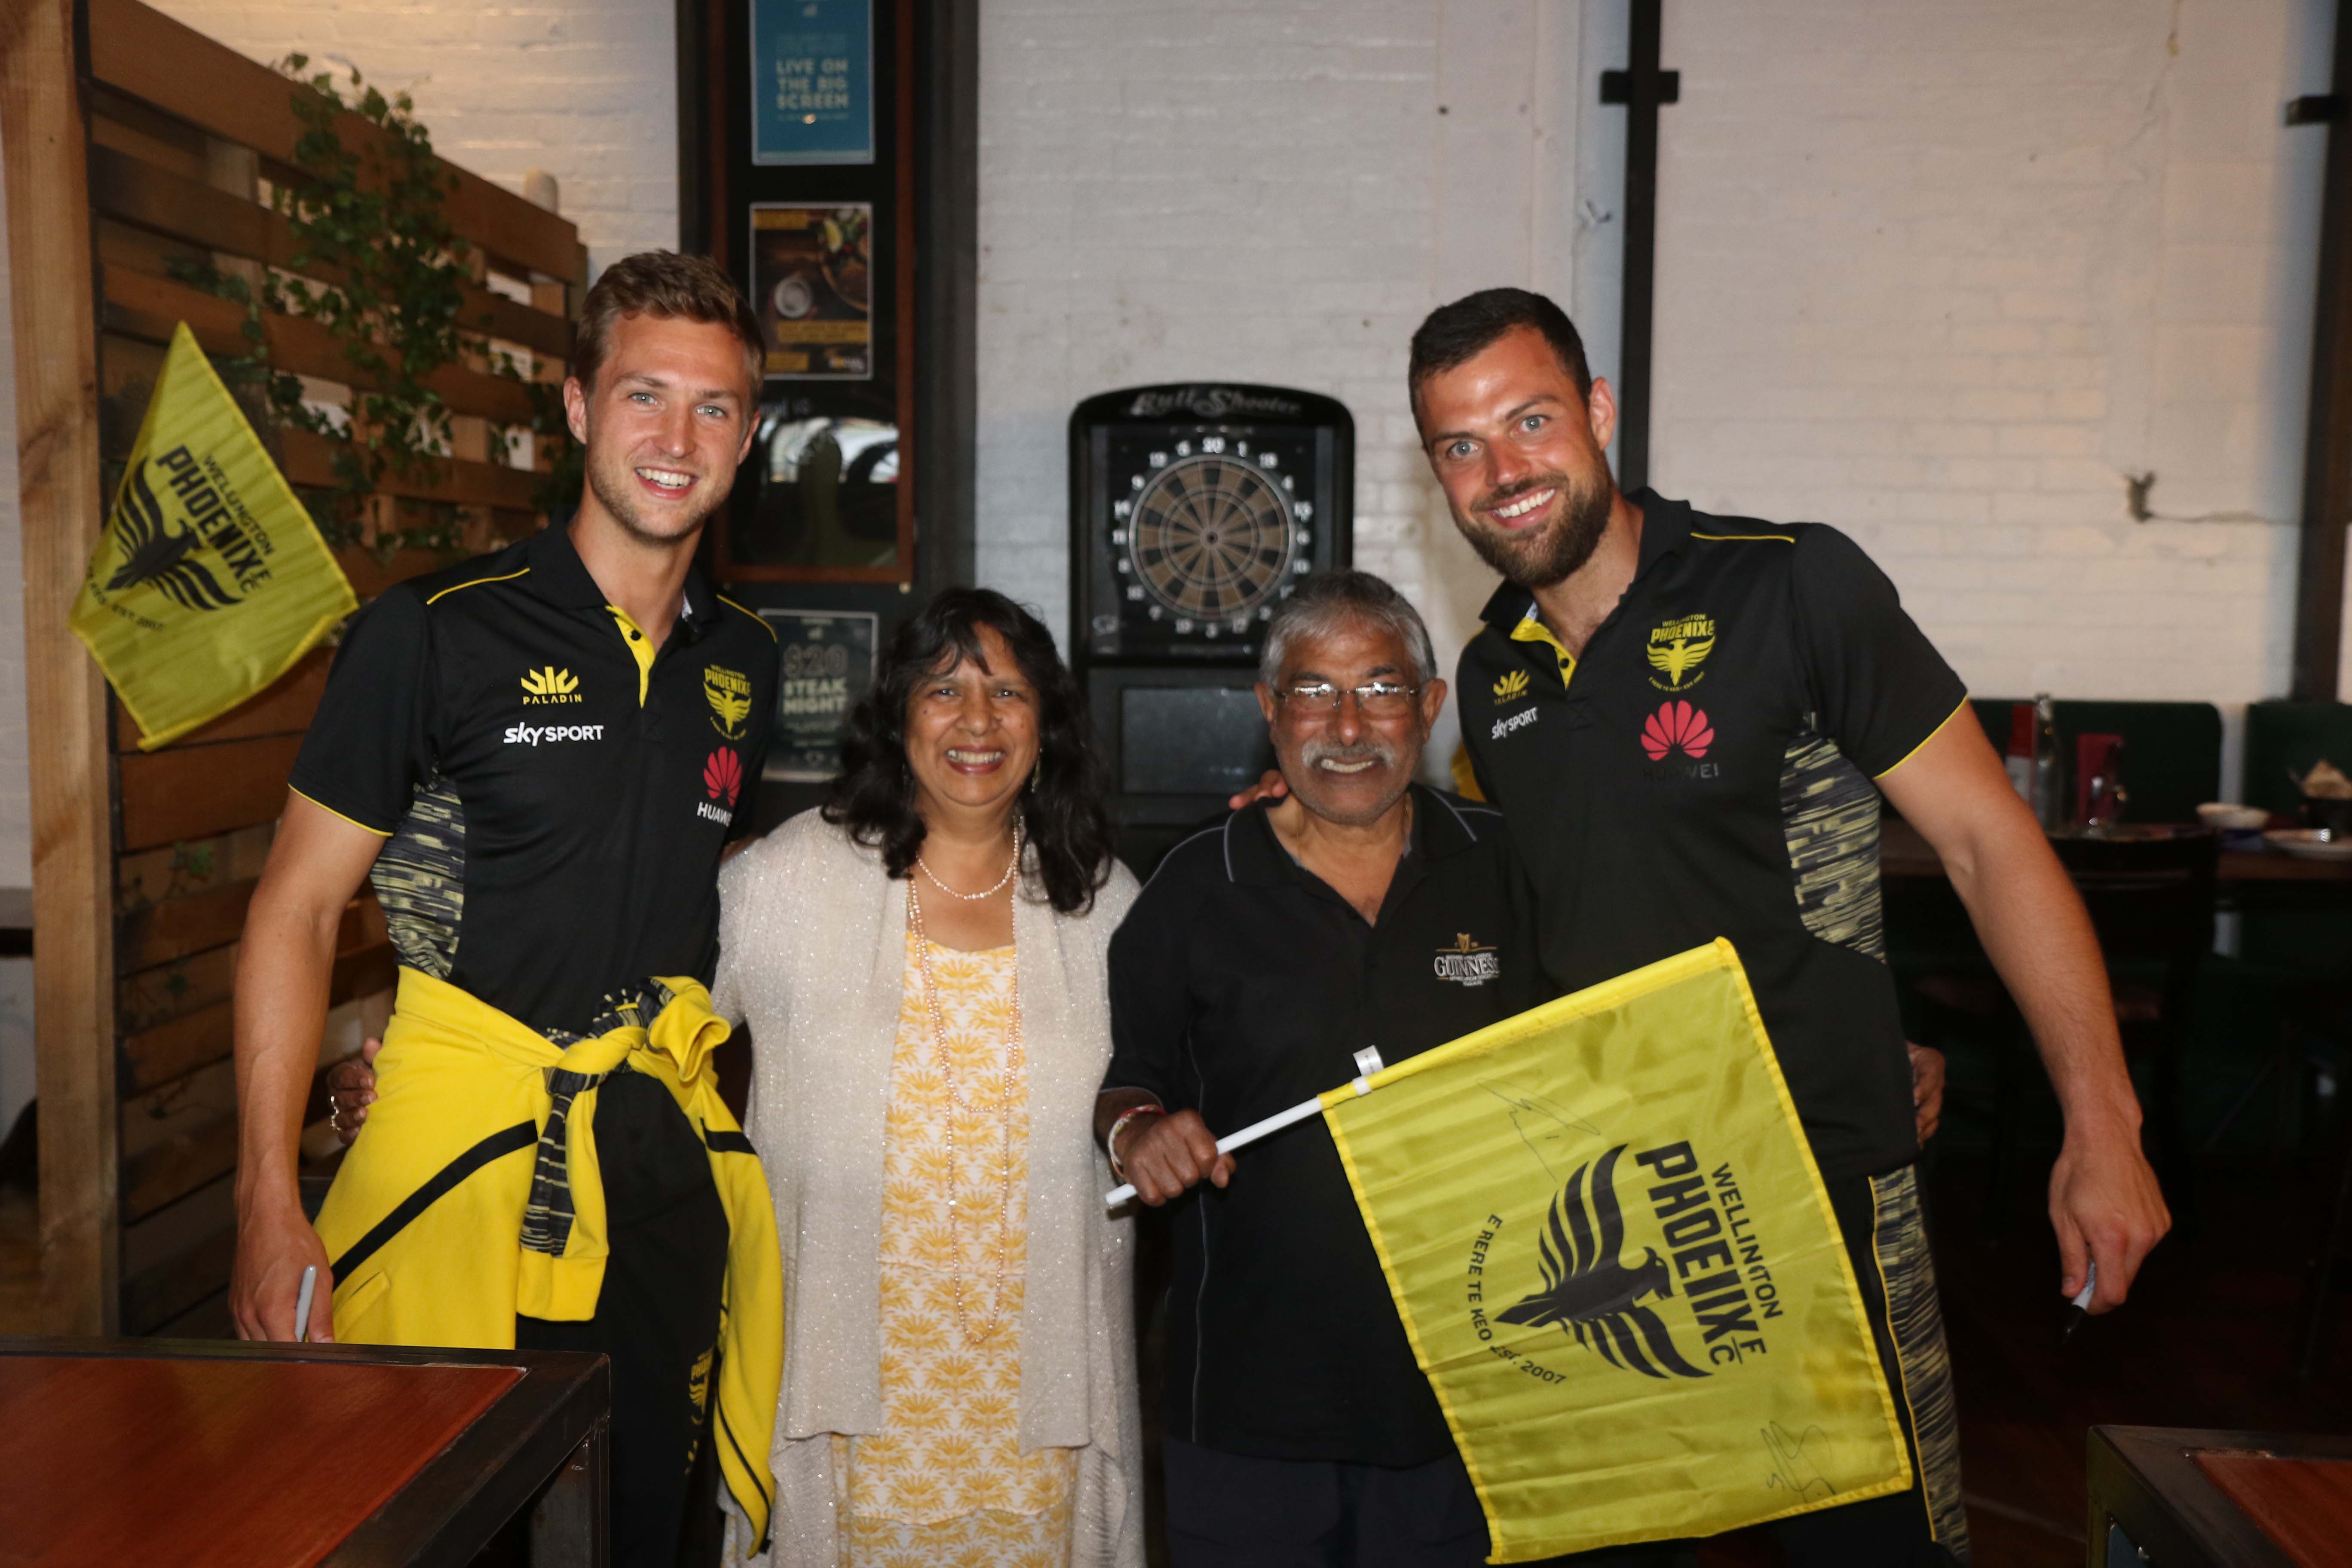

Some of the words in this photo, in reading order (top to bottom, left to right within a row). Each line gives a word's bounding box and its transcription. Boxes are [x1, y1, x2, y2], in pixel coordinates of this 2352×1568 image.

[776, 58, 813, 74] LIVE
[821, 58, 848, 73] ON
[778, 76, 809, 91] THE
[818, 76, 848, 90] BIG
[777, 93, 849, 110] SCREEN
[1175, 439, 1191, 456] 5
[1202, 436, 1226, 454] 20
[1237, 441, 1248, 457] 1
[1148, 451, 1168, 467] 12
[1259, 453, 1279, 469] 18
[1130, 474, 1145, 491] 9
[1280, 475, 1294, 491] 4
[156, 444, 264, 579] PHOENIX
[203, 454, 276, 554] WELLINGTON
[1113, 499, 1132, 521] 14
[1293, 500, 1313, 521] 13
[1112, 529, 1127, 545] 11
[1296, 530, 1311, 546] 6
[1117, 557, 1131, 574] 8
[1292, 558, 1311, 575] 10
[1148, 604, 1163, 621] 7
[1205, 622, 1218, 639] 3
[1650, 620, 1708, 644] PHOENIX
[784, 643, 848, 678] $20
[783, 679, 847, 696] STEAK
[523, 693, 583, 705] PALADIN
[783, 697, 846, 714] NIGHT
[1487, 1213, 1503, 1230] E
[1467, 1229, 1494, 1277] RERE
[1467, 1280, 1482, 1303] TE
[1470, 1307, 1493, 1341] KEO
[1519, 1359, 1567, 1385] 2007
